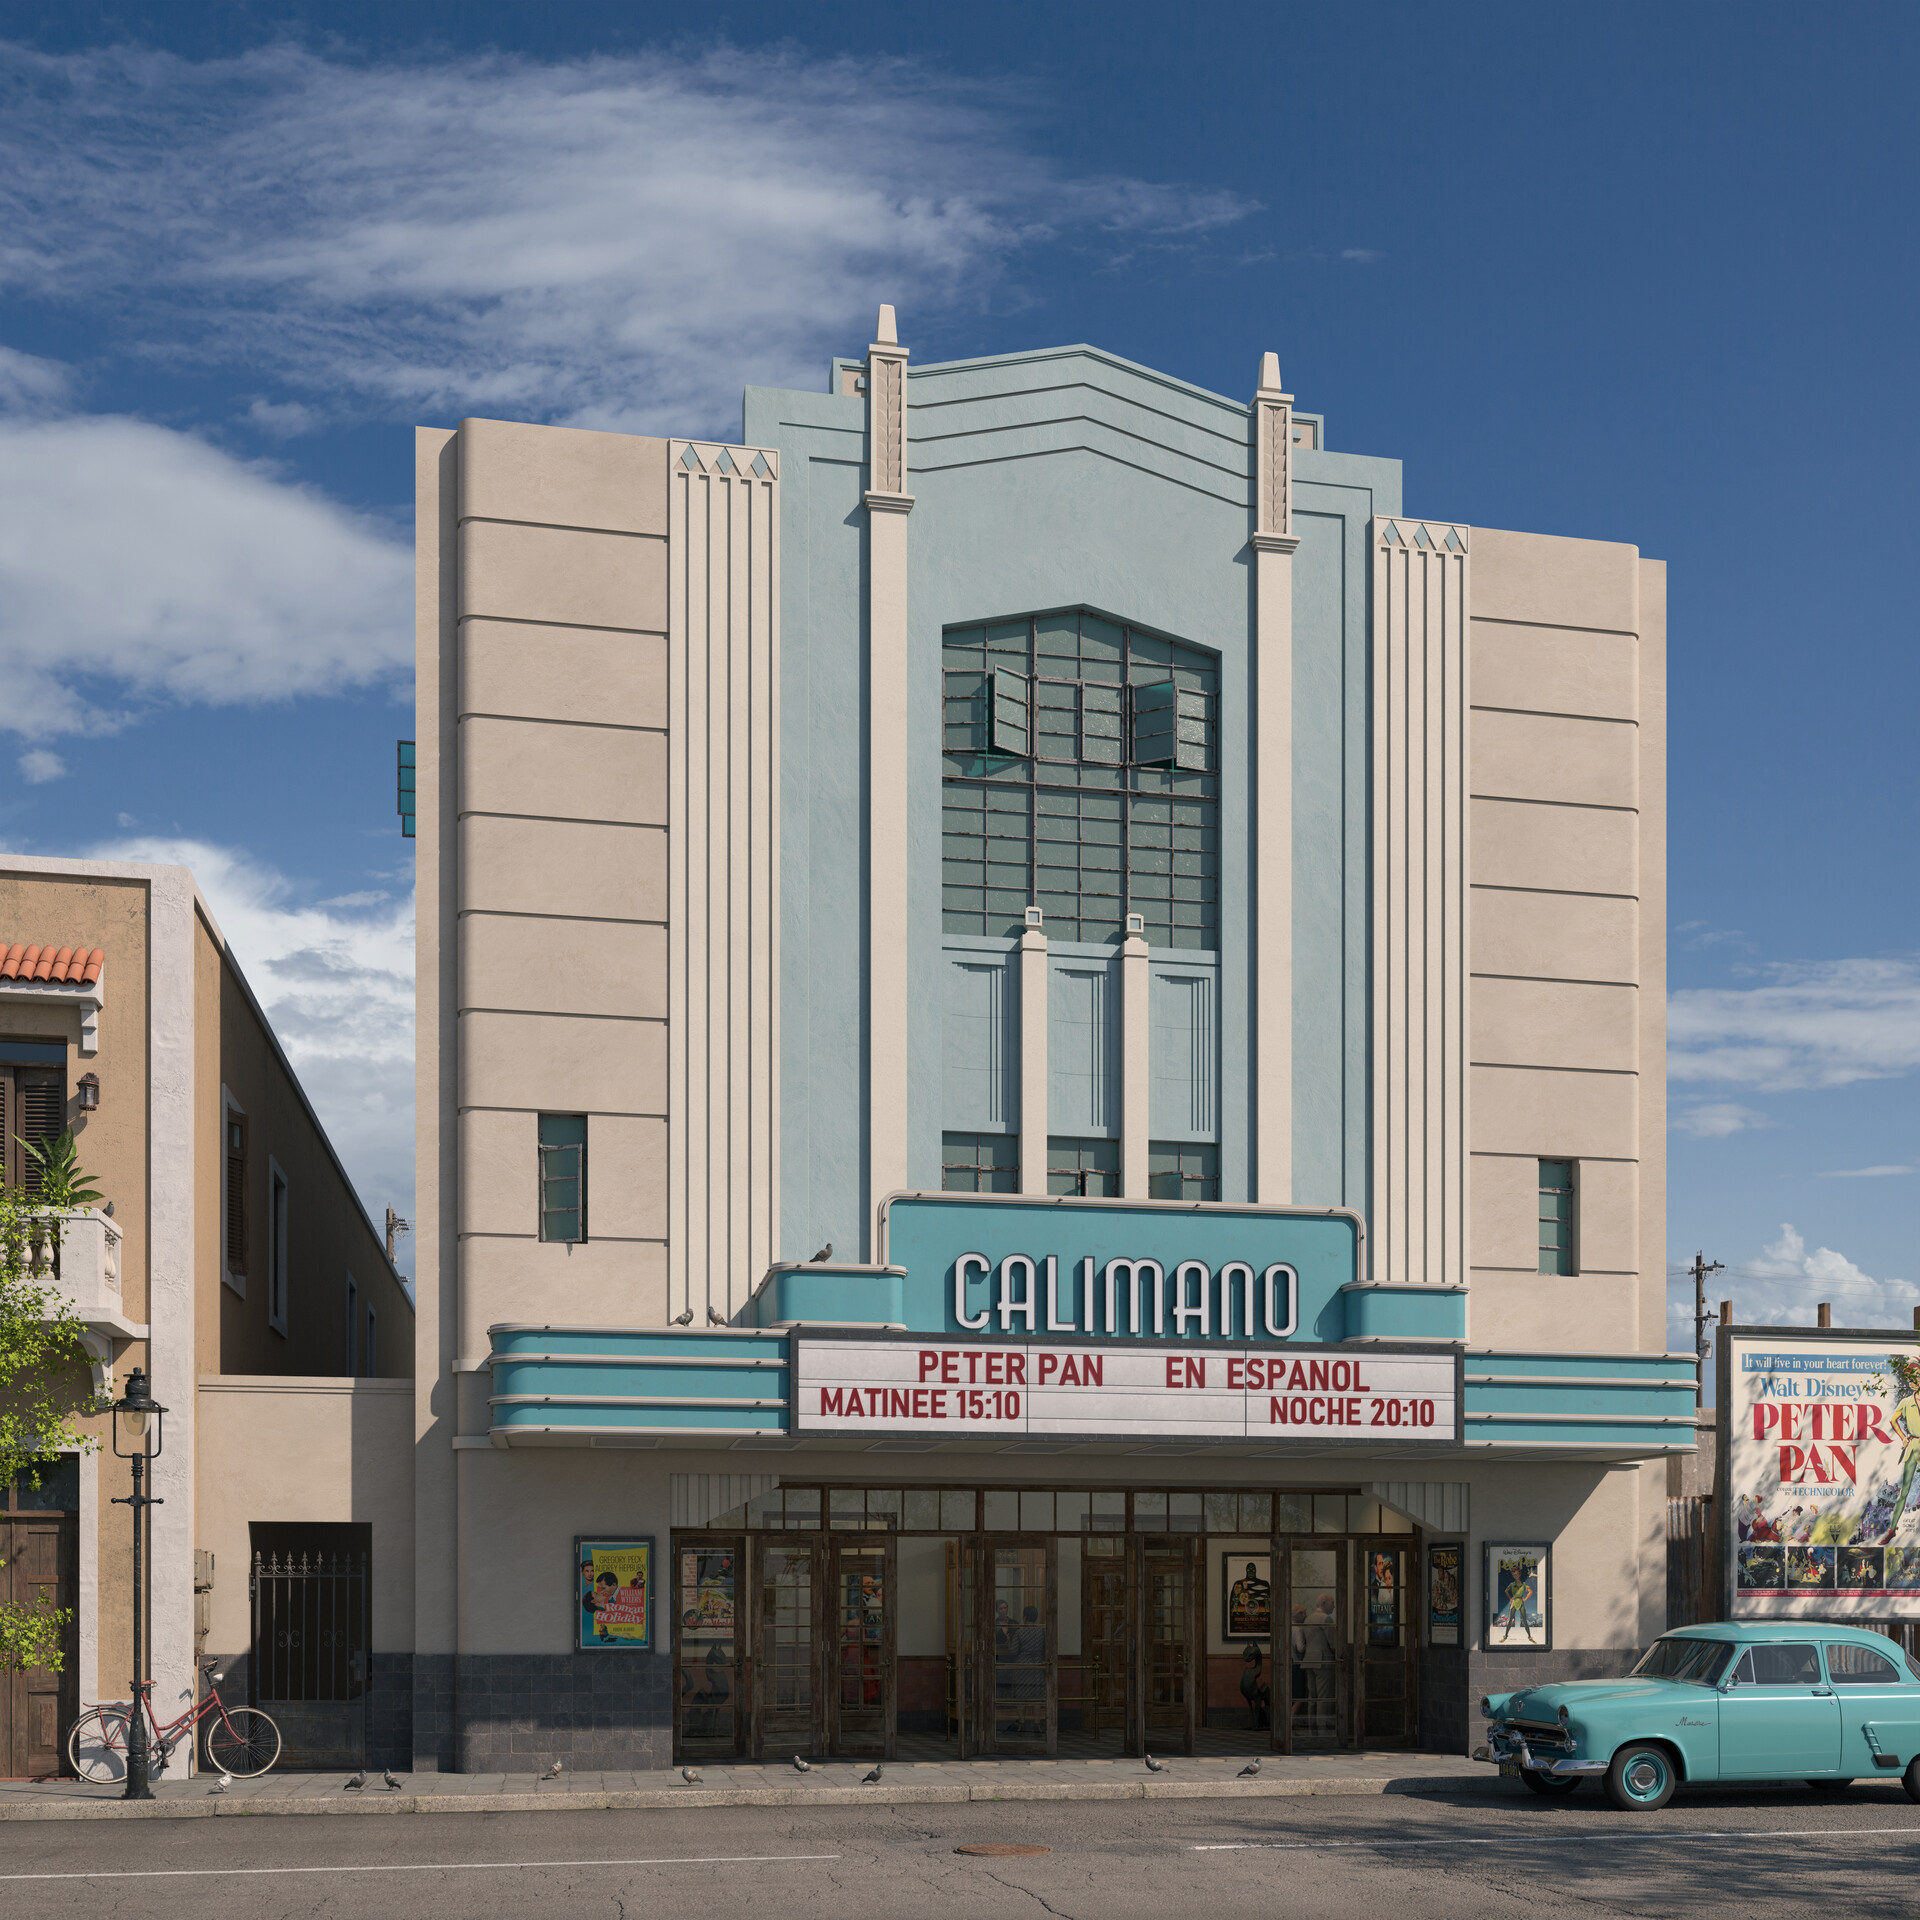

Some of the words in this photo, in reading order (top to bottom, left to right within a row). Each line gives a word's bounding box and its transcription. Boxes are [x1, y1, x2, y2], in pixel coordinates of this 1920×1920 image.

[953, 1252, 1299, 1338] CALIMANO
[919, 1350, 1027, 1386] PETER
[1038, 1353, 1104, 1387] PAN
[1165, 1356, 1206, 1389] EN
[1227, 1357, 1371, 1393] ESPANOL
[1745, 1354, 1753, 1368] It
[1755, 1356, 1772, 1369] will
[1774, 1357, 1791, 1369] live
[1792, 1357, 1801, 1369] in
[1803, 1360, 1824, 1371] your
[1826, 1358, 1849, 1370] heart
[1851, 1358, 1887, 1370] forever!
[1760, 1377, 1800, 1398] Walt
[1805, 1378, 1877, 1402] Disney's
[820, 1387, 948, 1419] MATINEE
[956, 1389, 1021, 1421] 15:10
[1270, 1396, 1363, 1427] NOCHE
[1370, 1398, 1435, 1428] 20:10
[1752, 1403, 1894, 1444] PETER
[1775, 1443, 1859, 1485] PAN
[1793, 1487, 1855, 1497] TECHNICOLOR
[595, 1564, 618, 1572] AUDREY
[618, 1563, 646, 1572] HEPBURN
[598, 1555, 626, 1564] GREGORY
[628, 1556, 643, 1564] PECK
[1440, 1552, 1457, 1567] Robe
[604, 1602, 644, 1614] Roman
[1373, 1604, 1395, 1614] TITANIC
